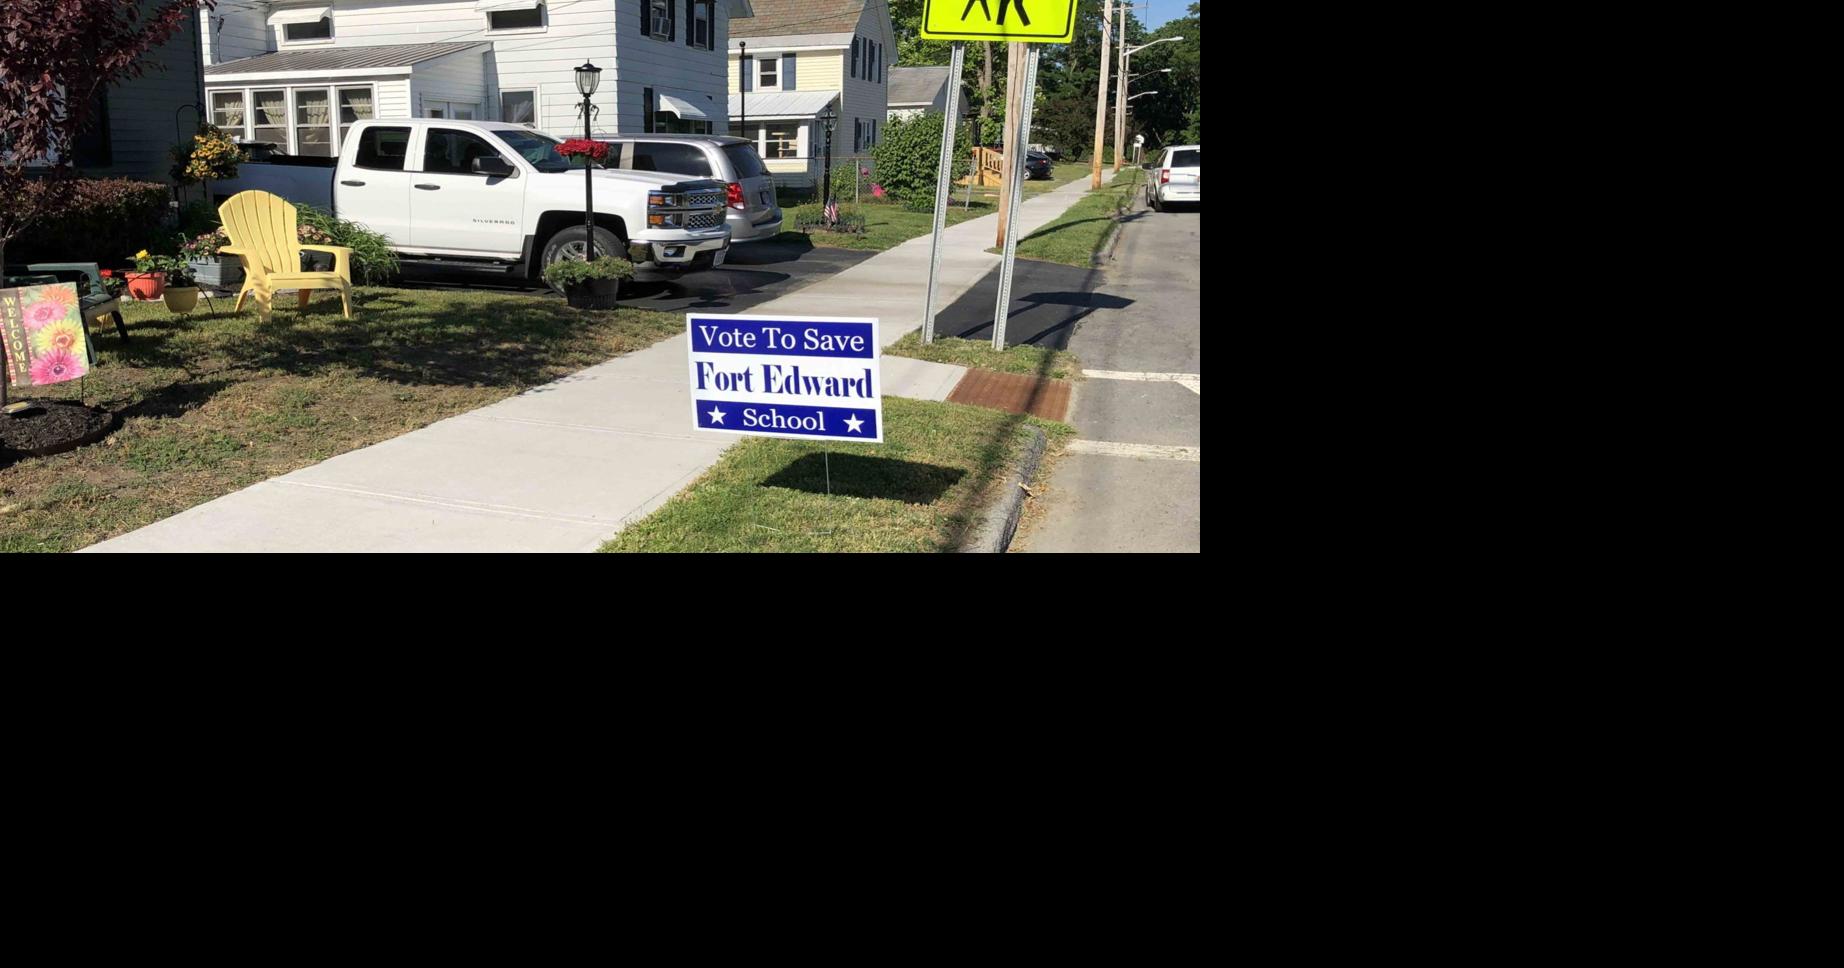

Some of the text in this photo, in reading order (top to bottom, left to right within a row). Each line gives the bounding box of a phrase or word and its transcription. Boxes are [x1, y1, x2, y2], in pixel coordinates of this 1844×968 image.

[4, 296, 27, 373] WELCOME
[699, 325, 865, 352] Vote To Save
[695, 361, 874, 399] Fort Edward
[743, 408, 826, 431] School
